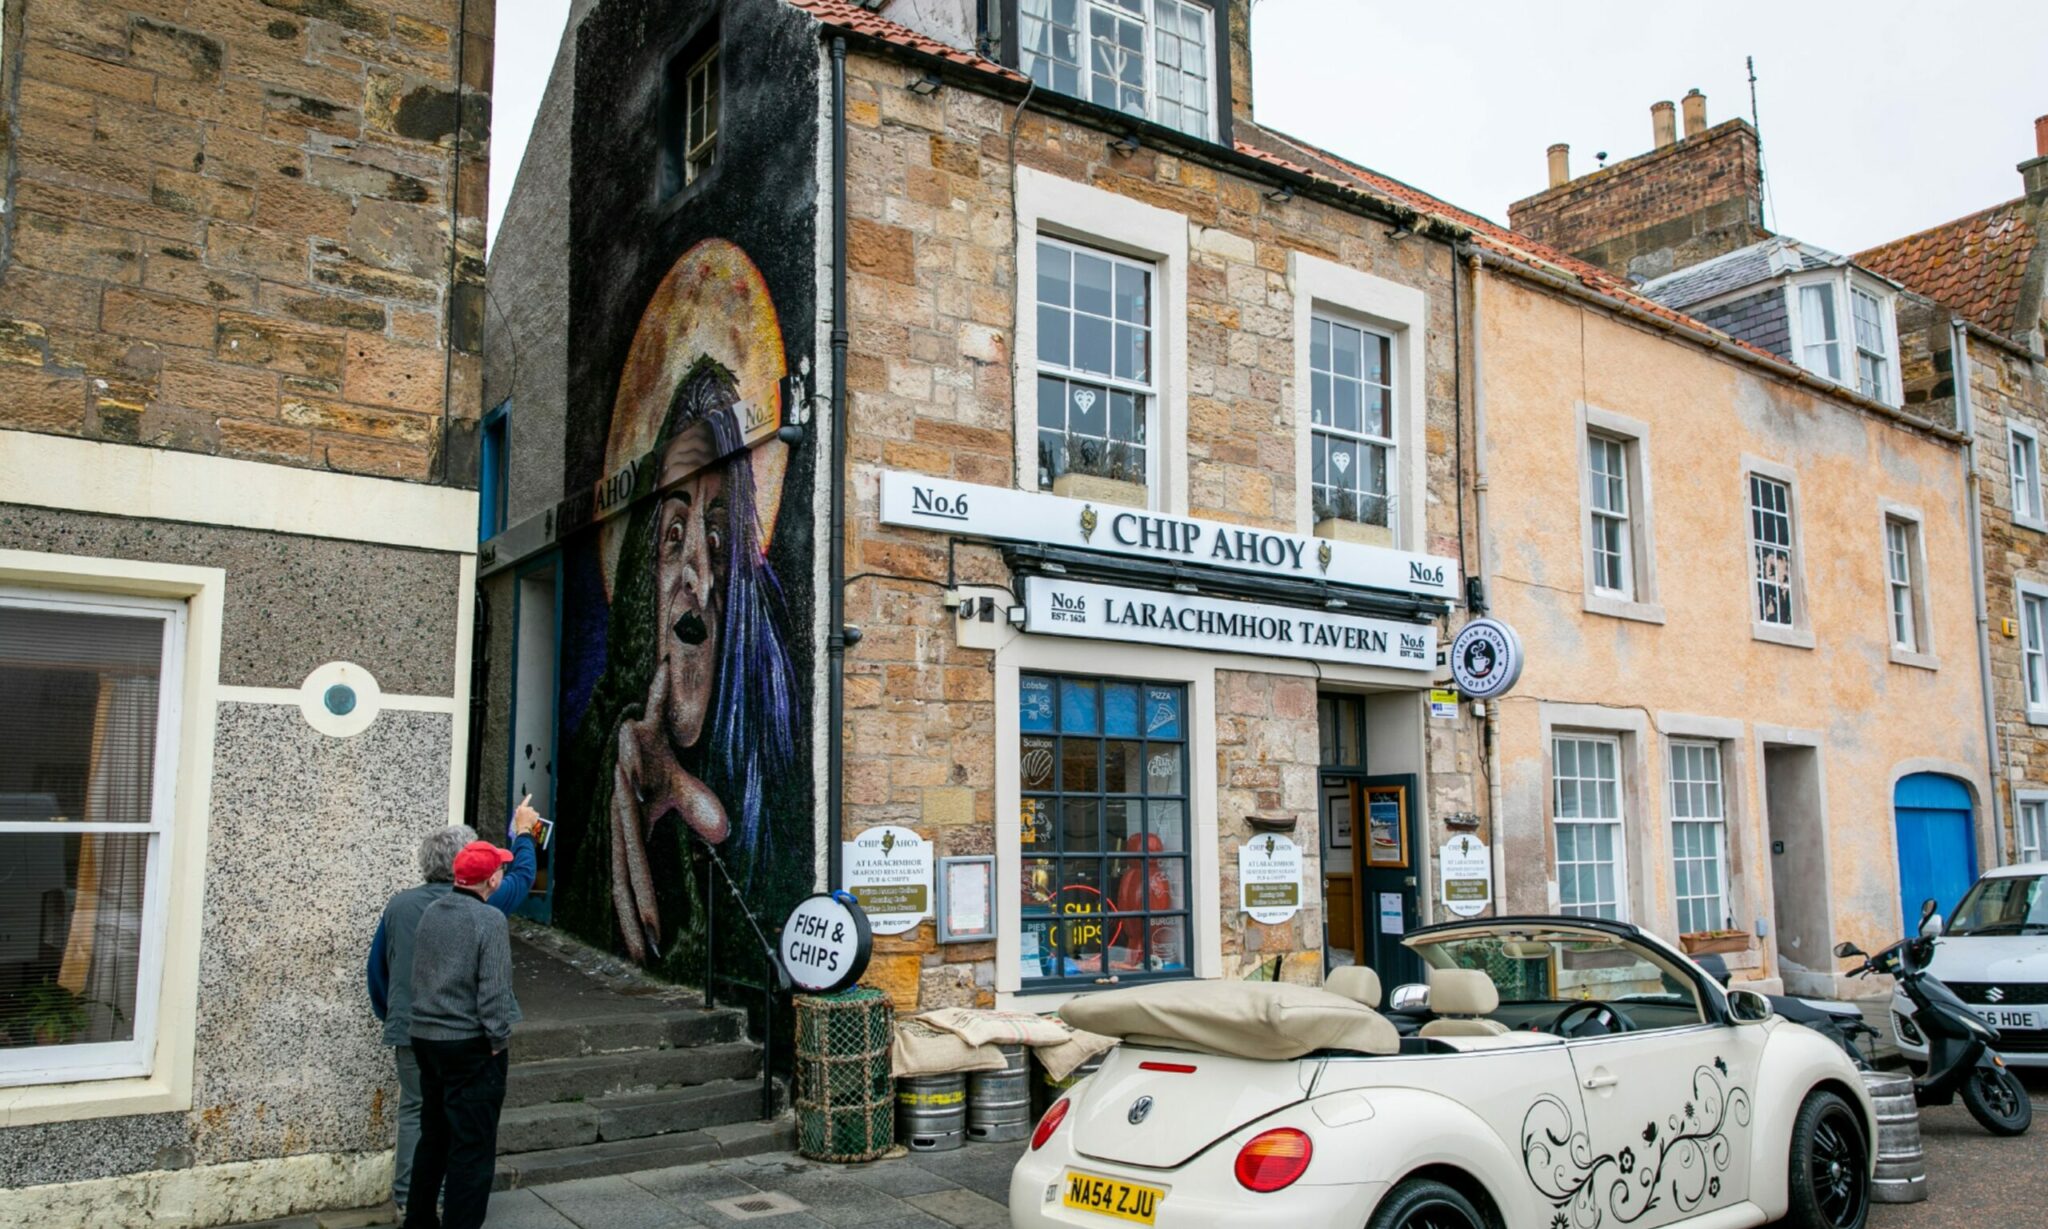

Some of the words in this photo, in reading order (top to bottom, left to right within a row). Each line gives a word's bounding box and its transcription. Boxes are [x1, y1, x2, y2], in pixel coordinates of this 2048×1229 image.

[912, 486, 968, 515] No.6
[1112, 512, 1200, 554] CHIP
[1211, 529, 1306, 569] AHOY
[1409, 561, 1444, 584] No.6
[1051, 592, 1085, 610] No.6
[1051, 612, 1069, 622] EST.
[1104, 598, 1291, 642] LARACHMHOR
[1300, 622, 1388, 653] TAVERN
[1400, 633, 1424, 648] No.6
[1456, 630, 1479, 659] ITALIAN
[1483, 630, 1503, 654] AROMA
[1463, 674, 1498, 688] COFFEE
[1151, 691, 1171, 700] PIZZA
[858, 840, 879, 848] CHIP
[895, 839, 919, 847] AHOY
[794, 913, 829, 939] FISH
[831, 922, 845, 944] &
[1028, 923, 1046, 932] PIES
[790, 941, 839, 972] CHIPS
[2001, 1011, 2033, 1027] HDE
[1070, 1178, 1113, 1210] NA54
[1116, 1186, 1155, 1217] ZJU
